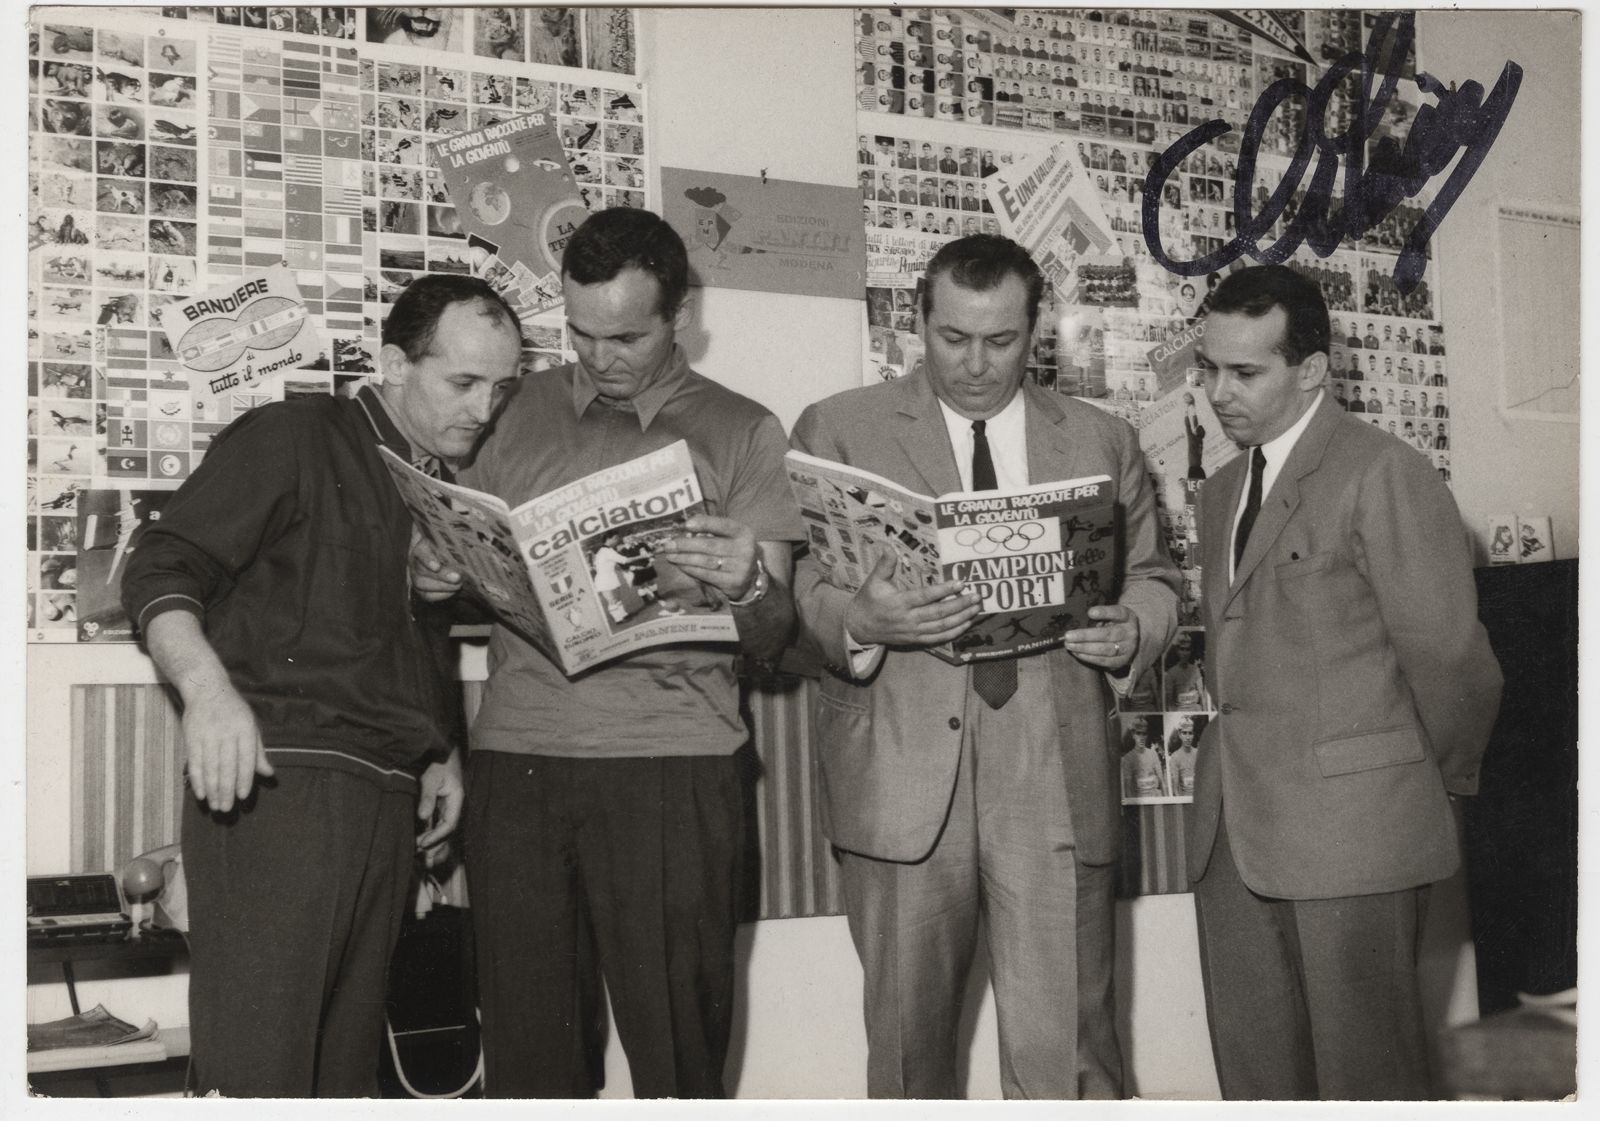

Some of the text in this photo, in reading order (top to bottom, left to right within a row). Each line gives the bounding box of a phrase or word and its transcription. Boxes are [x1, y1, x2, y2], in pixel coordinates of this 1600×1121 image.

[436, 142, 450, 157] LE
[449, 131, 485, 152] GRANDI
[484, 118, 528, 141] RACCOLTE
[527, 113, 546, 129] PER
[450, 139, 511, 168] LA GIOVENTÙ
[997, 178, 1021, 223] È
[1015, 175, 1039, 207] UNA
[556, 222, 577, 236] LA
[776, 214, 830, 227] EDIZIONI
[778, 258, 834, 271] MODENA
[183, 278, 269, 321] BANDIERE
[247, 351, 255, 361] di
[208, 348, 303, 394] tutto il mondo
[518, 511, 534, 527] LE
[533, 483, 584, 516] GRANDI
[940, 484, 1100, 516] LE GRANDI RACCOLTE PER
[528, 478, 695, 561] calciatori
[534, 514, 553, 532] LA
[954, 507, 1039, 526] LA GIOVENTÙ
[549, 592, 574, 608] SERIE
[962, 575, 1055, 613] PORT
[1017, 637, 1054, 651] PANINI
